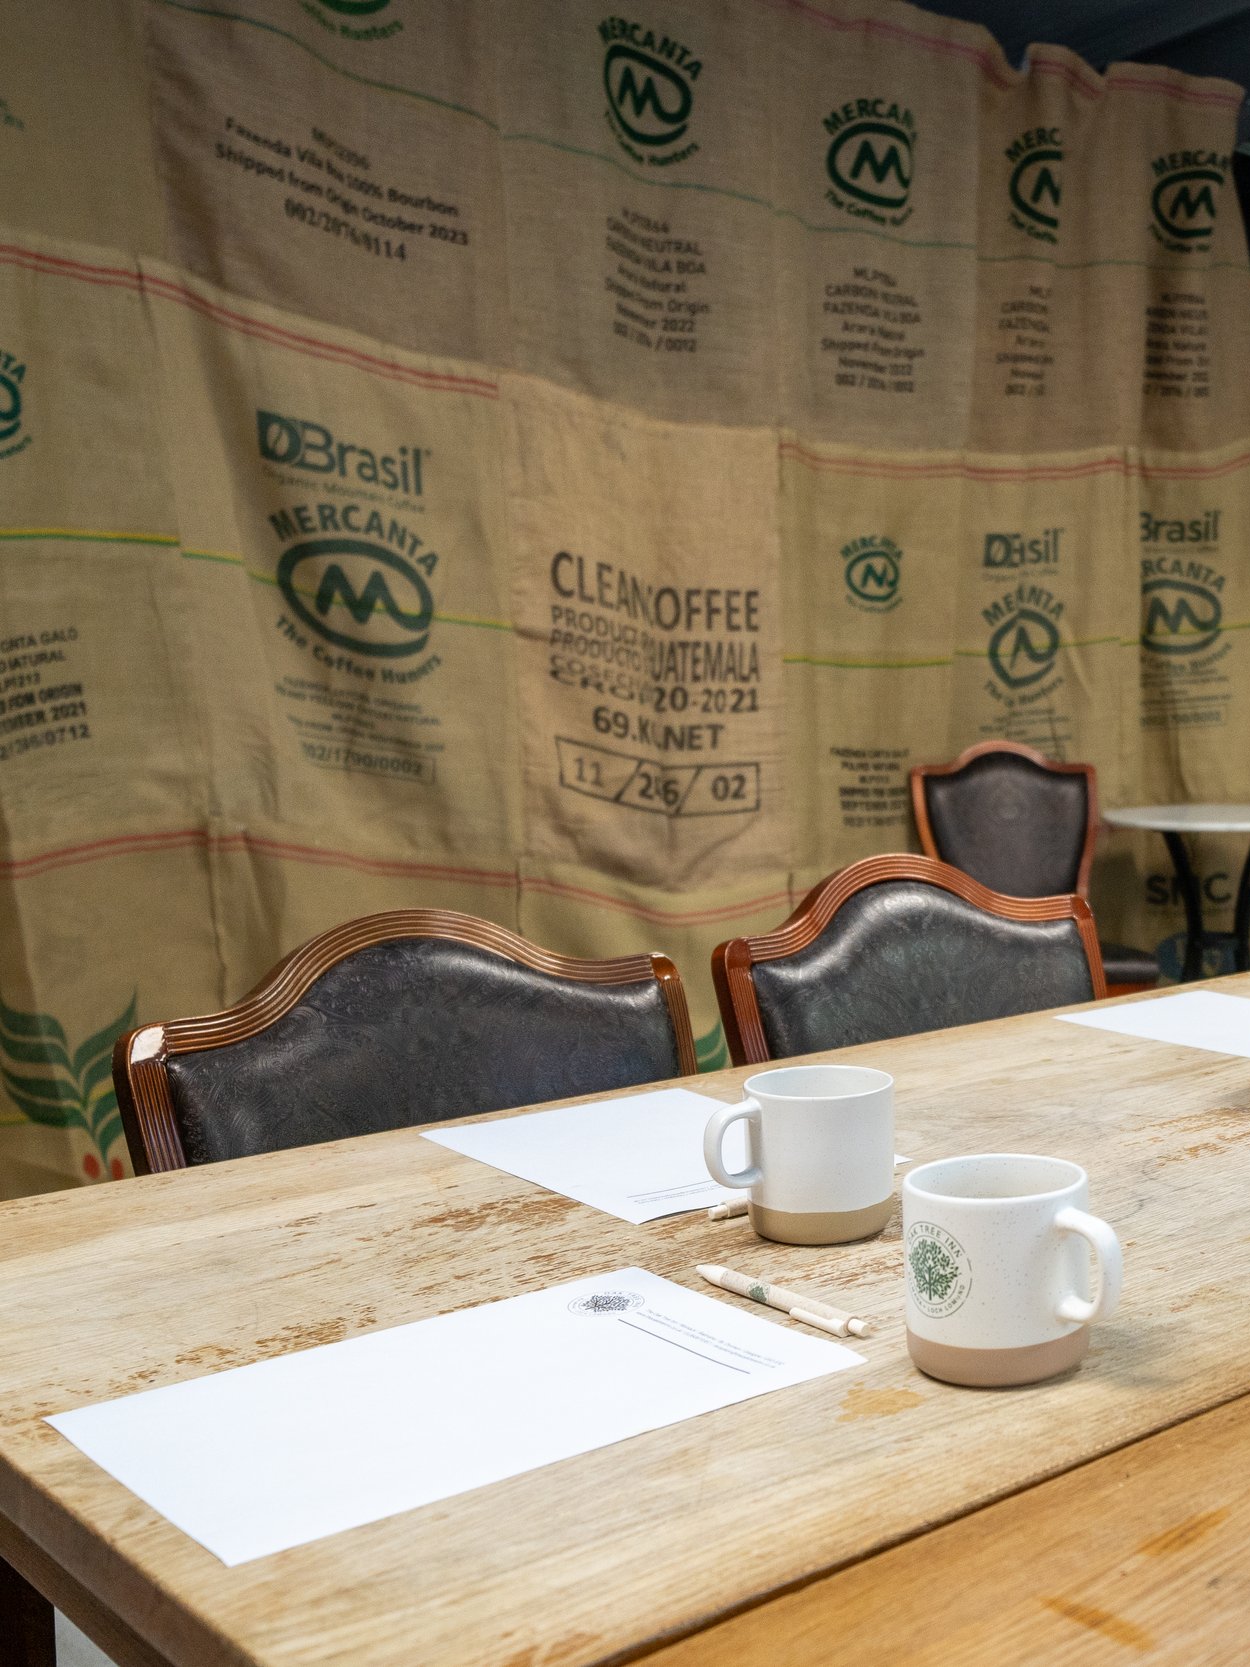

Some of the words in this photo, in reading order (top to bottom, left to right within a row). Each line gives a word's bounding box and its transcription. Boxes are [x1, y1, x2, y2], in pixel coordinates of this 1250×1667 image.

[598, 16, 703, 81] MERCANTA
[1005, 127, 1063, 161] MERC
[215, 143, 286, 182] Shipped
[361, 207, 424, 235] October
[428, 223, 469, 246] 2023
[387, 189, 459, 217] Bourbon
[676, 259, 705, 275] BOA
[667, 298, 711, 316] Origin
[661, 318, 696, 333] 2022
[268, 503, 440, 577] MERCANTA
[550, 551, 648, 623] CLEAN
[650, 586, 760, 633] OFFEE
[275, 614, 309, 651] The
[312, 640, 375, 680] Coffee
[650, 640, 761, 683] UATEMALA
[650, 686, 760, 714] 20-2021
[639, 772, 680, 806] 26
[711, 773, 747, 802] 02
[1146, 872, 1232, 906] SC
[920, 1224, 942, 1239] TREE
[944, 1236, 963, 1258] INN
